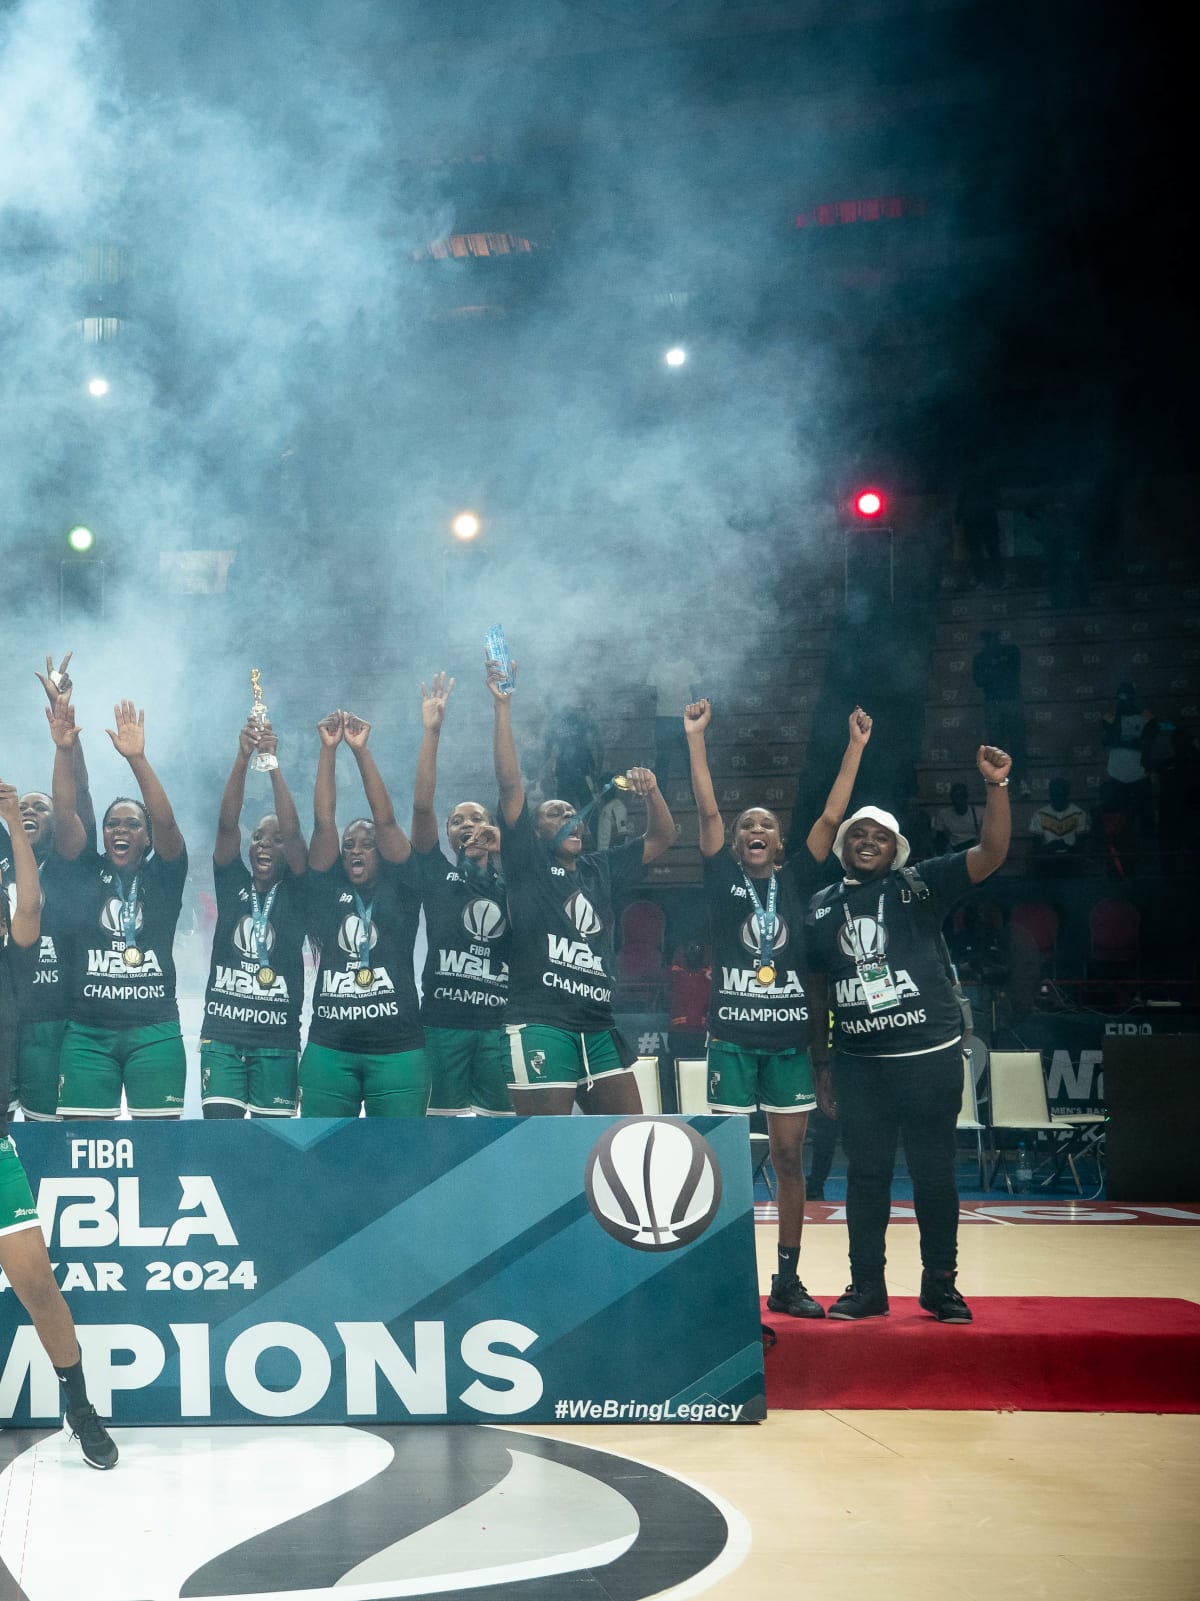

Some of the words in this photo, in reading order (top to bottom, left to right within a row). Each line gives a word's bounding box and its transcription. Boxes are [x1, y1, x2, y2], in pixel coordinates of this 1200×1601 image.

[551, 866, 565, 877] BA
[339, 892, 353, 903] BA
[815, 906, 831, 920] IBA
[111, 941, 126, 950] FIB
[469, 944, 491, 957] FIBA
[547, 933, 604, 972] WB
[346, 961, 362, 971] FIB
[439, 949, 509, 982] WBLA
[753, 958, 775, 969] FA
[215, 965, 289, 998] WBLA
[322, 967, 395, 994] WBA
[542, 971, 611, 1003] CHAMPION
[722, 966, 805, 995] WBLA
[835, 969, 919, 1003] WA
[83, 984, 165, 1000] CHAMPIONS
[255, 994, 273, 1002] LEAGUE
[434, 987, 509, 1007] CHAMPION
[207, 1001, 287, 1025] CHAMPIONS
[318, 1002, 399, 1020] CHAMPIONS
[718, 1006, 809, 1022] CHAMPIONS
[841, 1009, 927, 1034] CHAMPIONS
[72, 1138, 134, 1169] FIBA
[145, 1260, 257, 1291] 2024
[555, 1399, 744, 1421] #WeBringLegacy
